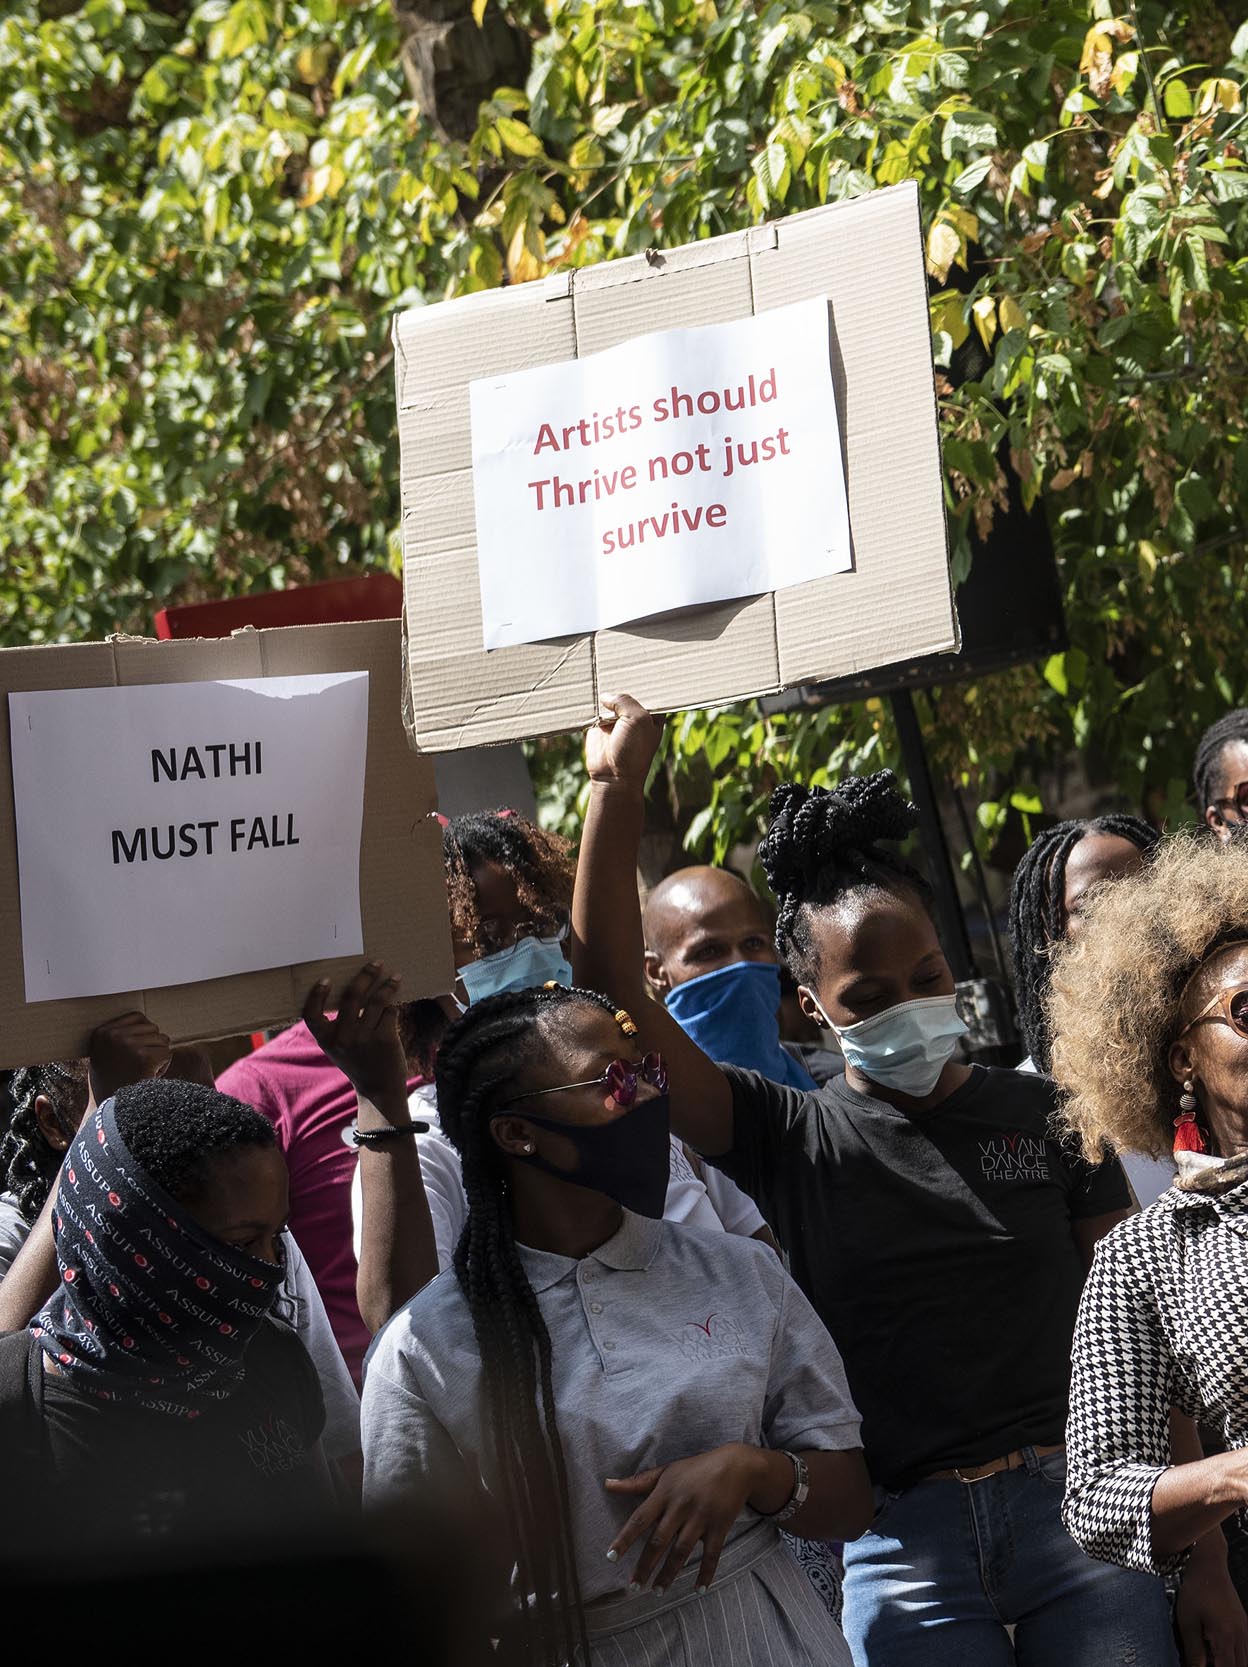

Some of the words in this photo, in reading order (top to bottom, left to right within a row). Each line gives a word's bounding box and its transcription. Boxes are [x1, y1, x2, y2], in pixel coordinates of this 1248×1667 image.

[533, 405, 642, 455] Artists
[653, 367, 778, 422] should
[528, 465, 637, 511] Thrive
[648, 443, 712, 482] not
[723, 427, 791, 477] just
[602, 502, 727, 555] survive
[151, 741, 262, 783] NATHI
[111, 821, 219, 864] MUST
[230, 813, 300, 852] FALL
[978, 1132, 1047, 1155] VUYANI
[981, 1153, 1048, 1171] DANCE
[78, 1140, 129, 1218] ASSUPOL
[982, 1169, 1049, 1180] THEATRE
[86, 1203, 158, 1279] ASSUPOL
[139, 1227, 219, 1299] ASSUPOL
[165, 1289, 240, 1341] ASSUPOL
